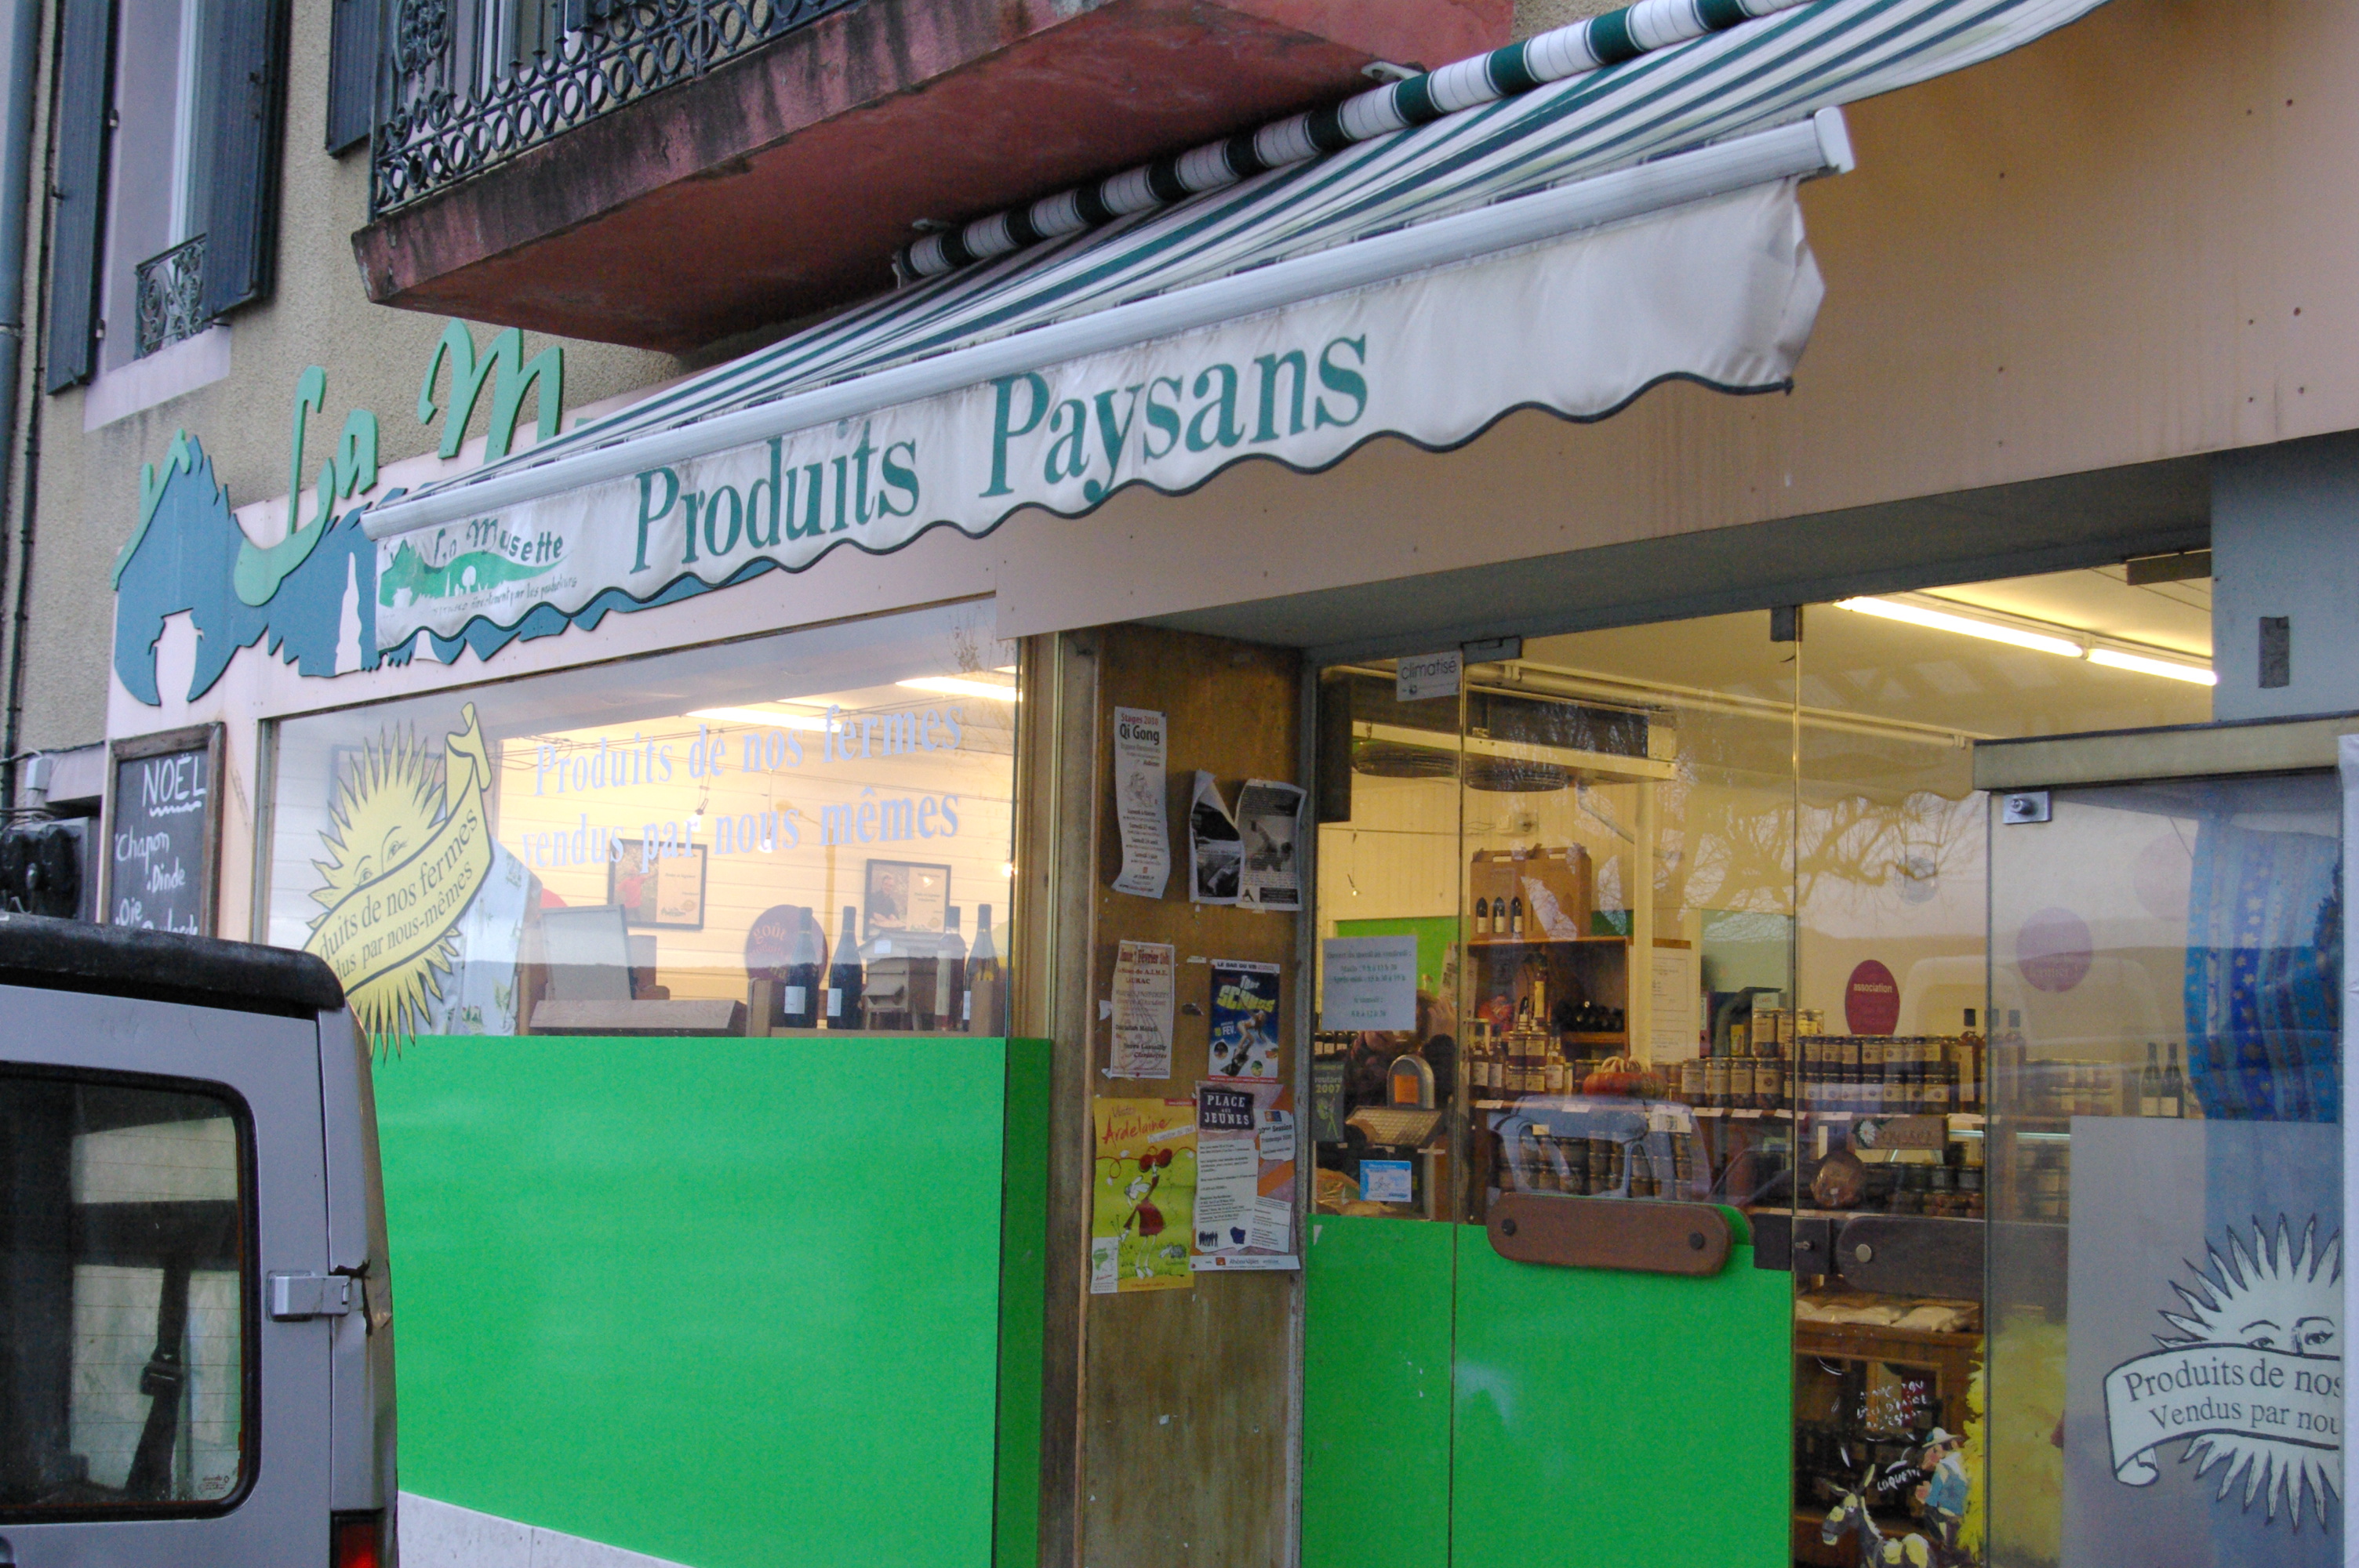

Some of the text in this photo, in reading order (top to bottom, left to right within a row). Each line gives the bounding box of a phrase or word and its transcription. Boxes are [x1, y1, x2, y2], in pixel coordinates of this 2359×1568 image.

[630, 333, 1368, 574] Produits Paysans
[466, 517, 564, 564] Musette
[1401, 655, 1457, 681] climatisé
[533, 704, 964, 797] Produits de nos fermes
[1119, 723, 1160, 746] Qi Gong
[142, 753, 207, 808] NOËL
[521, 786, 960, 874] vendus par nous mêmes
[117, 826, 170, 875] Chapon
[151, 856, 186, 893] Dinde
[319, 808, 478, 962] duits de nos fermes
[118, 897, 143, 926] Oie
[335, 861, 473, 981] dus par nous-mêmes
[1853, 982, 1893, 993] association
[1207, 1094, 1245, 1108] PLACE
[1315, 1084, 1341, 1094] 2007
[1102, 1115, 1173, 1149] Ardelaine
[1205, 1112, 1250, 1126] JEUNES
[2123, 1356, 2245, 1403] Produits
[2250, 1358, 2284, 1388] de
[2149, 1397, 2241, 1430] Vendus
[2251, 1403, 2290, 1428] par
